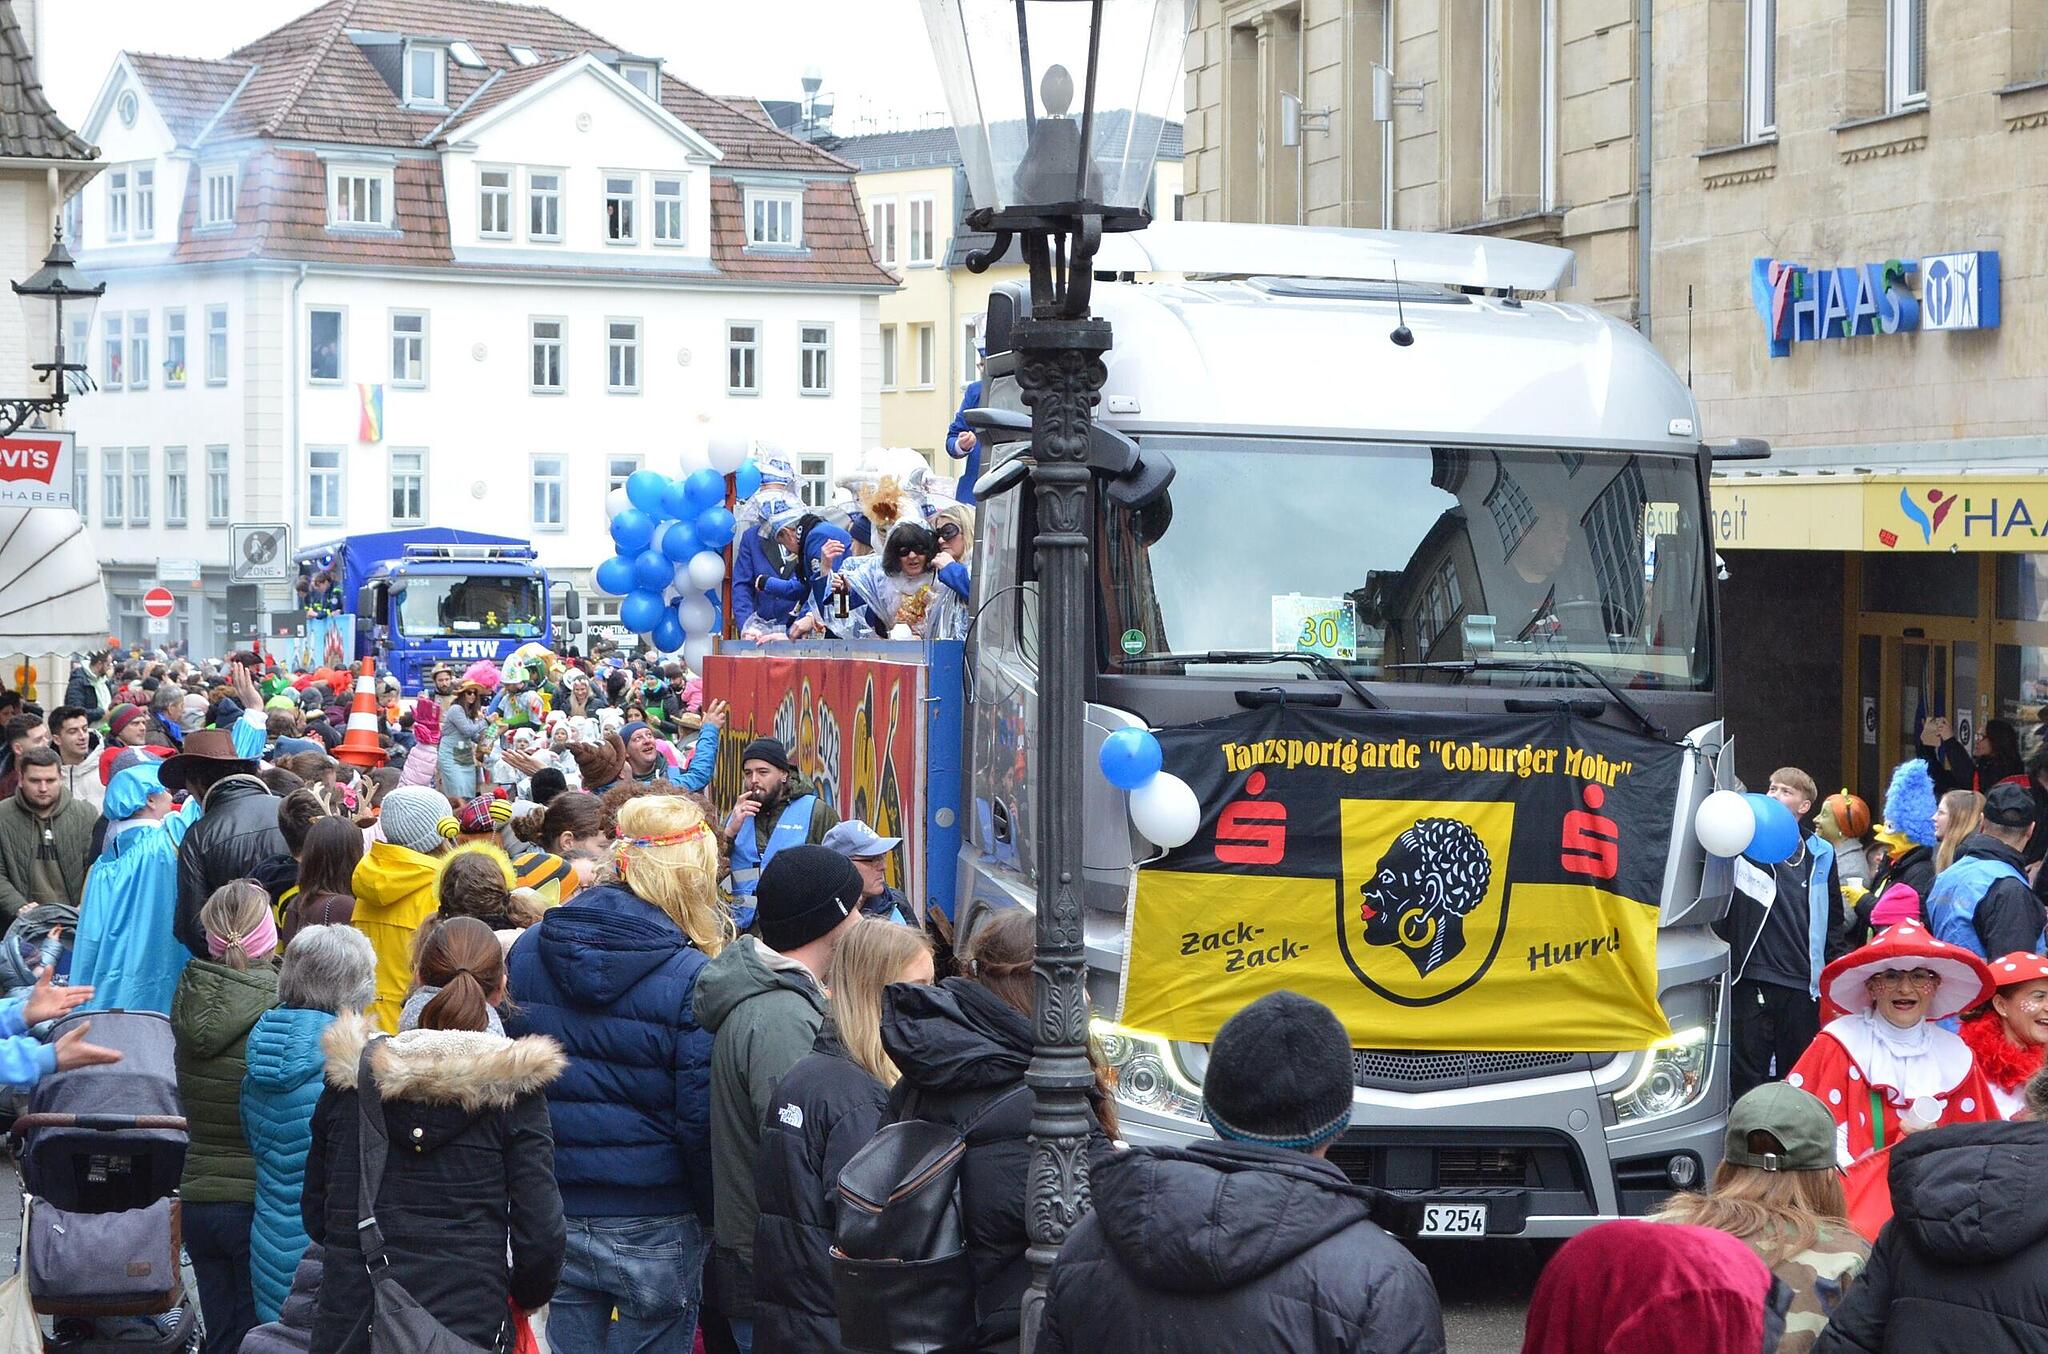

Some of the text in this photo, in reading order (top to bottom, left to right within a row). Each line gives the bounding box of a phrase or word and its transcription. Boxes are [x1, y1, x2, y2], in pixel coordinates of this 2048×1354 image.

[1794, 259, 1903, 343] HAAS
[0, 448, 49, 469] VI'S
[1964, 498, 2048, 537] HA
[448, 640, 499, 658] THW
[1298, 616, 1339, 648] 30
[1429, 741, 1558, 778] "Coburger
[1564, 746, 1632, 787] Mohr"
[1180, 921, 1265, 956] Zack-
[1225, 938, 1309, 972] Zack-
[1425, 1208, 1483, 1232] S 254
